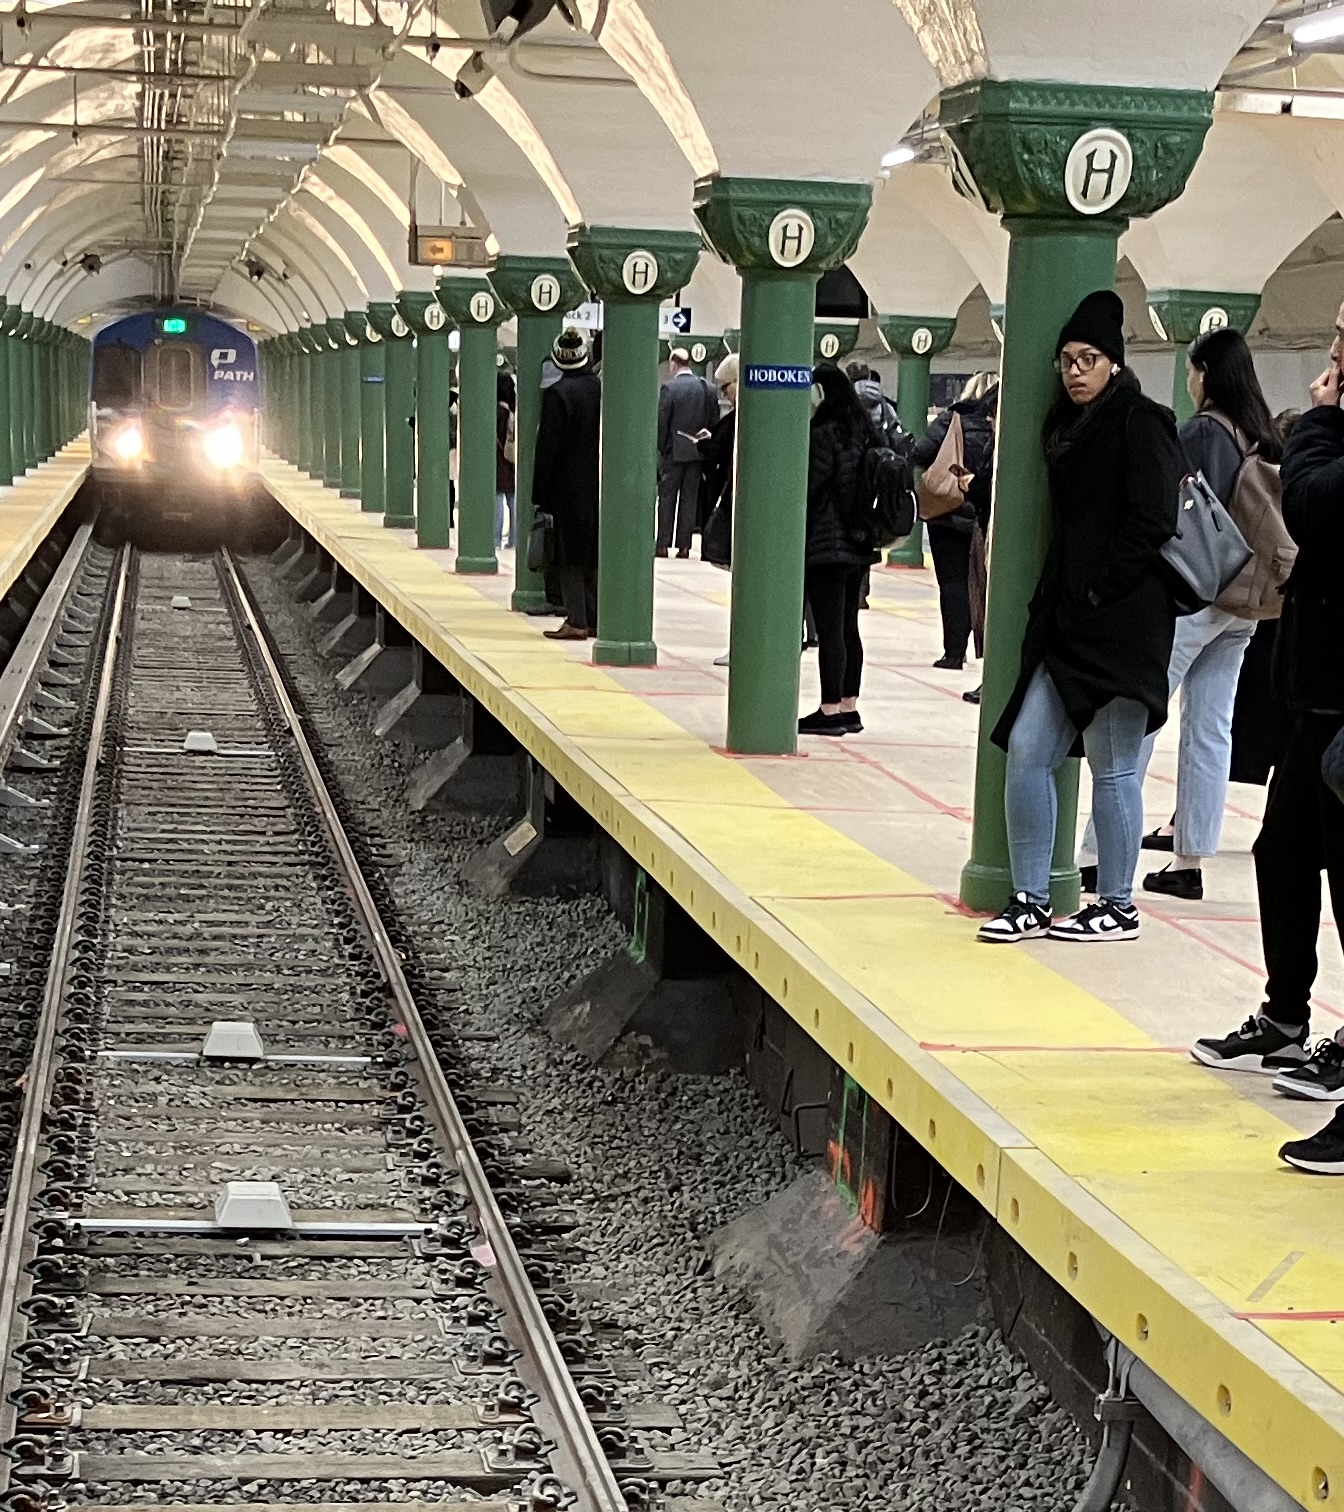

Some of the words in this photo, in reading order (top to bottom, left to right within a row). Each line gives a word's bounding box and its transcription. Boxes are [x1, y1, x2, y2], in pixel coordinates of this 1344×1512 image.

[1080, 147, 1118, 200] H
[780, 222, 804, 258] H
[631, 260, 650, 288] H
[538, 283, 553, 306] H
[476, 299, 488, 317] H
[430, 310, 440, 326] H
[825, 340, 836, 354] H
[917, 334, 929, 348] H
[213, 370, 255, 382] PATH
[749, 369, 812, 383] HOBOKEN
